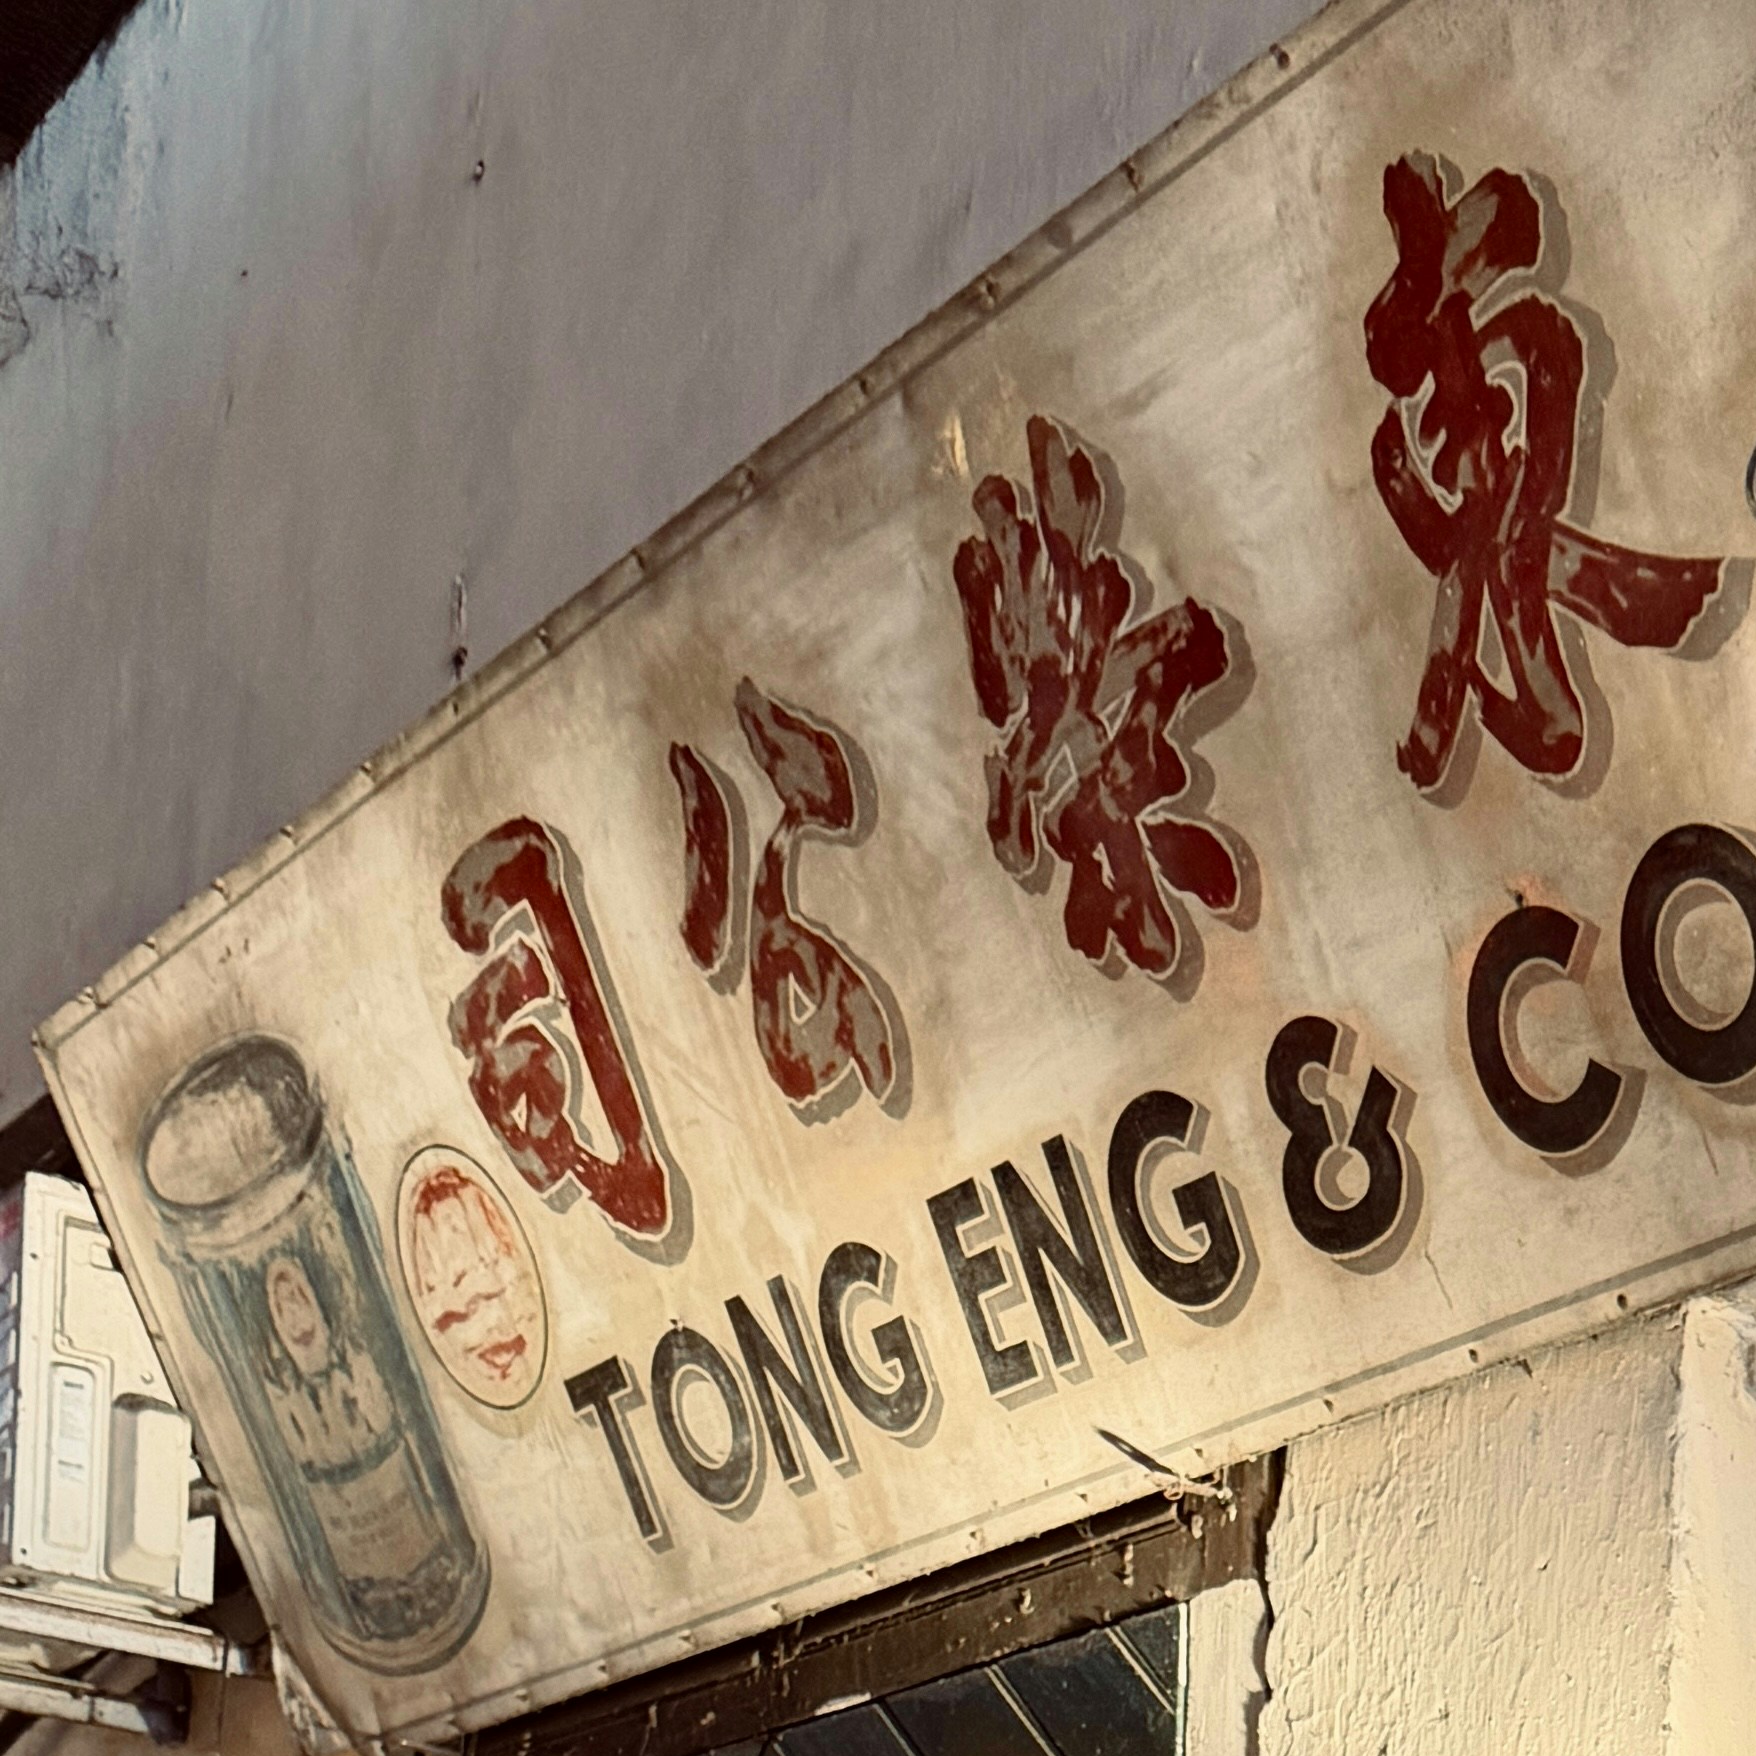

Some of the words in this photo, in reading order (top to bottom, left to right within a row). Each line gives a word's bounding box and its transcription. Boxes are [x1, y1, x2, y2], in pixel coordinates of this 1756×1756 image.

[564, 1238, 925, 1545] TONG
[928, 1088, 1250, 1402] ENG
[1263, 1014, 1405, 1256] &
